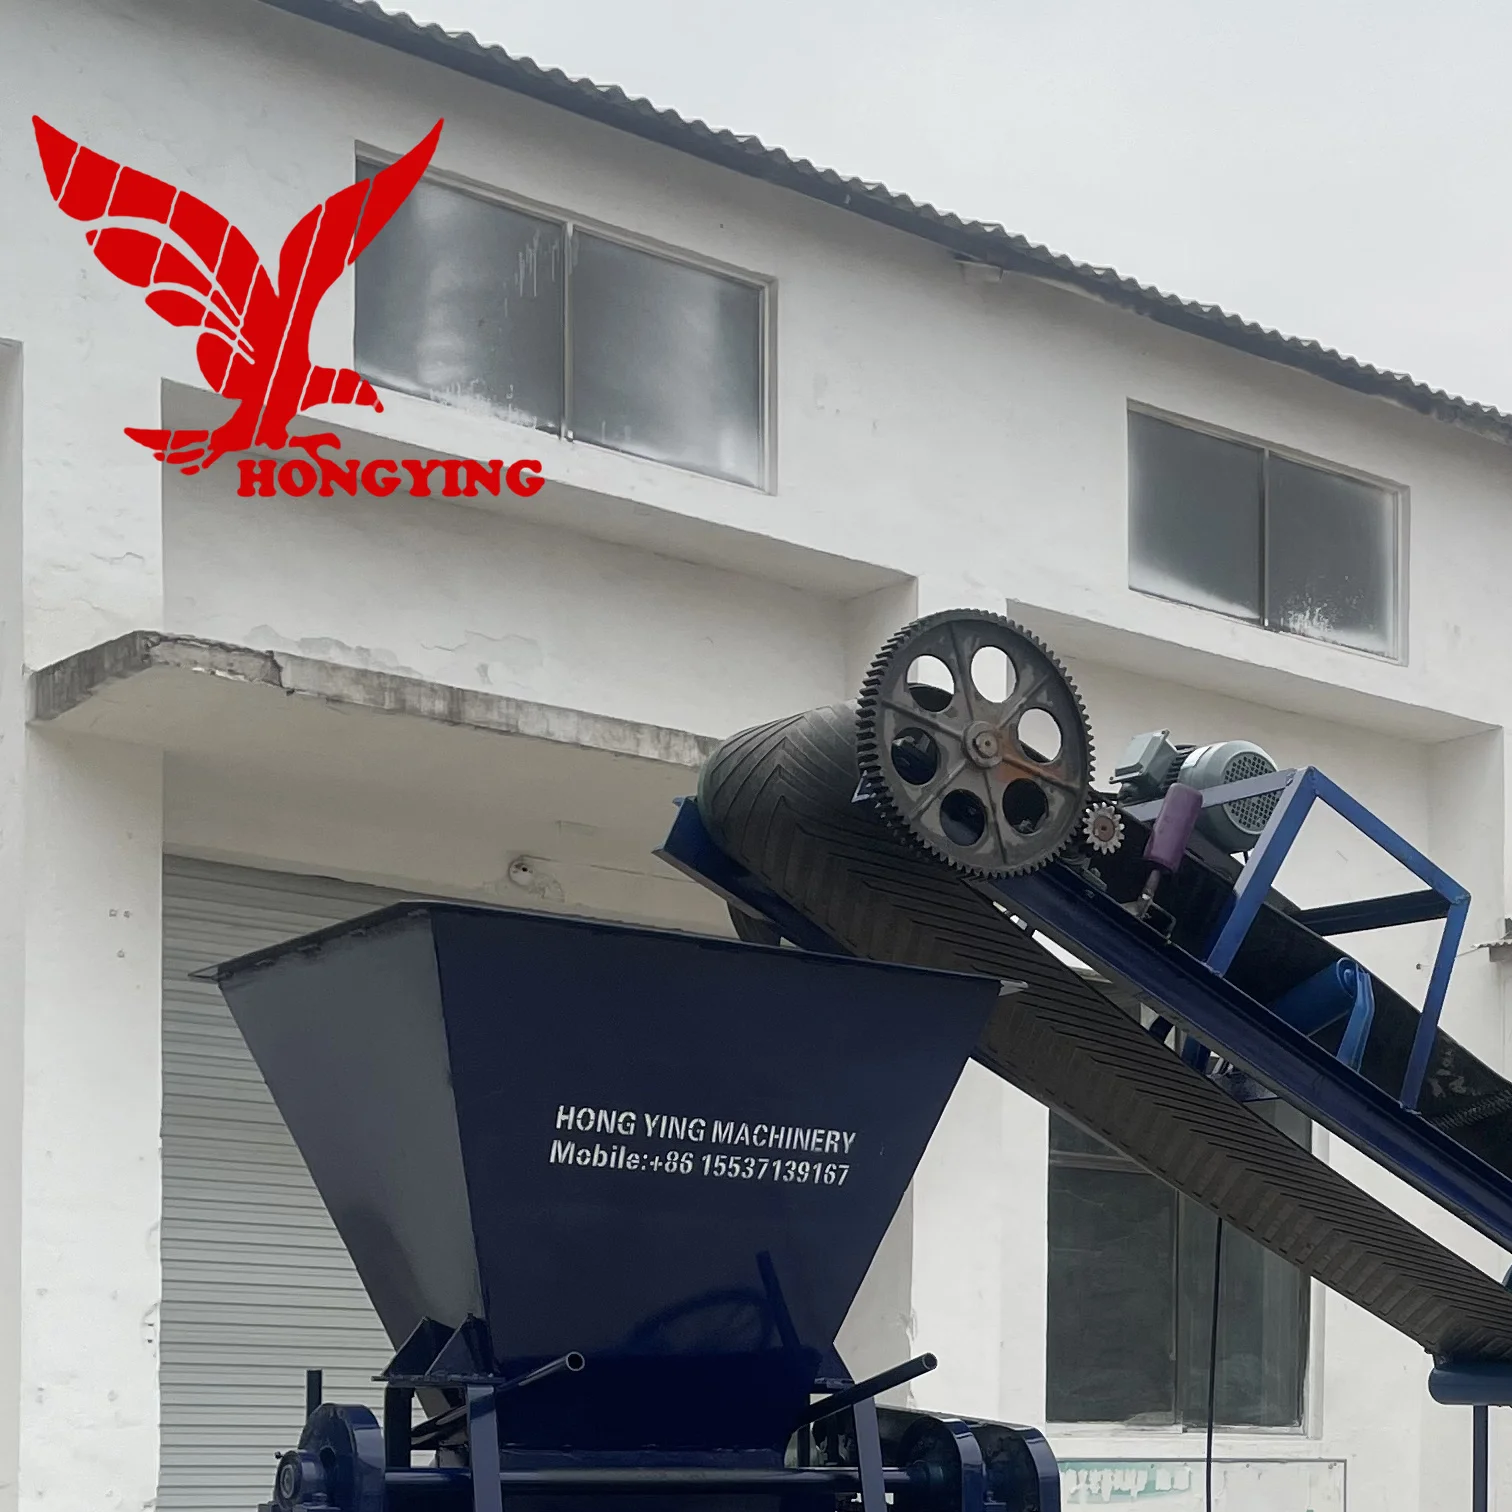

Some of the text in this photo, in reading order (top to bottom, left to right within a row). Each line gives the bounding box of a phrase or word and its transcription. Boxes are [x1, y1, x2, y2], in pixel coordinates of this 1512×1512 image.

[556, 1105, 857, 1154] HONG YING MACHINERY
[702, 1153, 850, 1186] 15537139167
